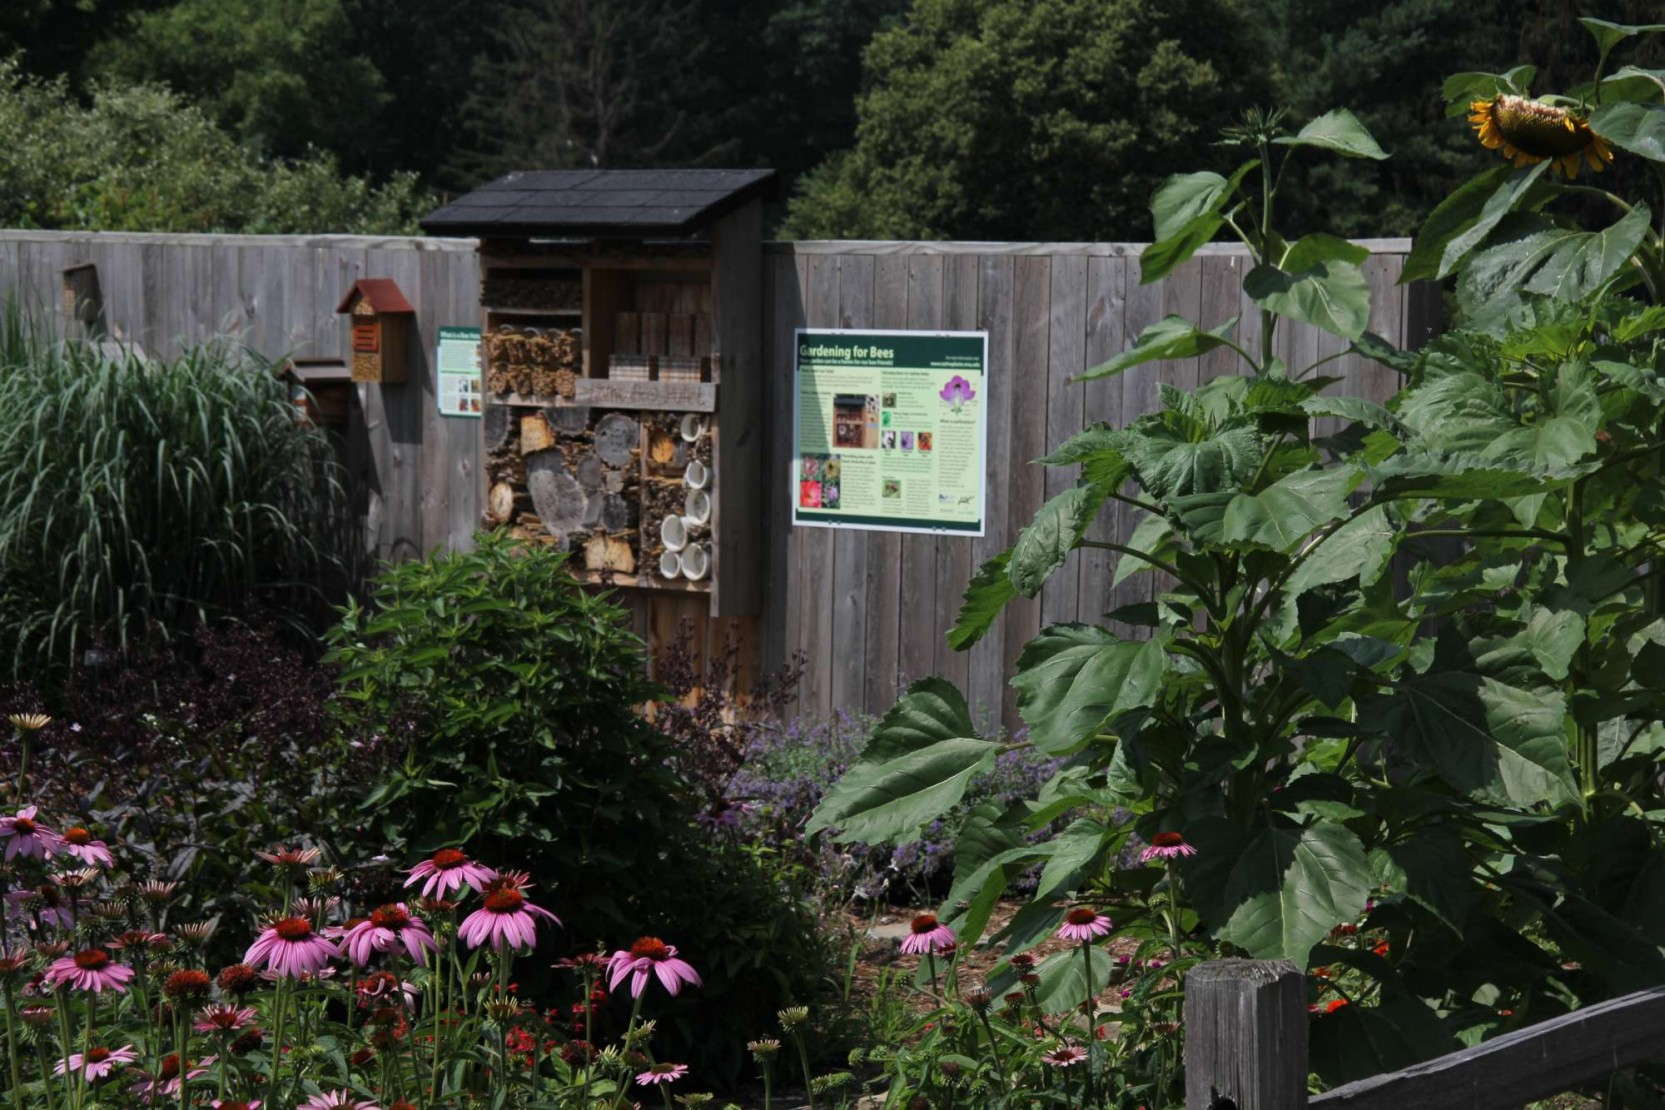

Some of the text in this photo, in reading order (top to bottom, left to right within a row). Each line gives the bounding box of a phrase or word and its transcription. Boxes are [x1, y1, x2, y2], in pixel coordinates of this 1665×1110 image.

[800, 344, 894, 360] Gardening for Bees
